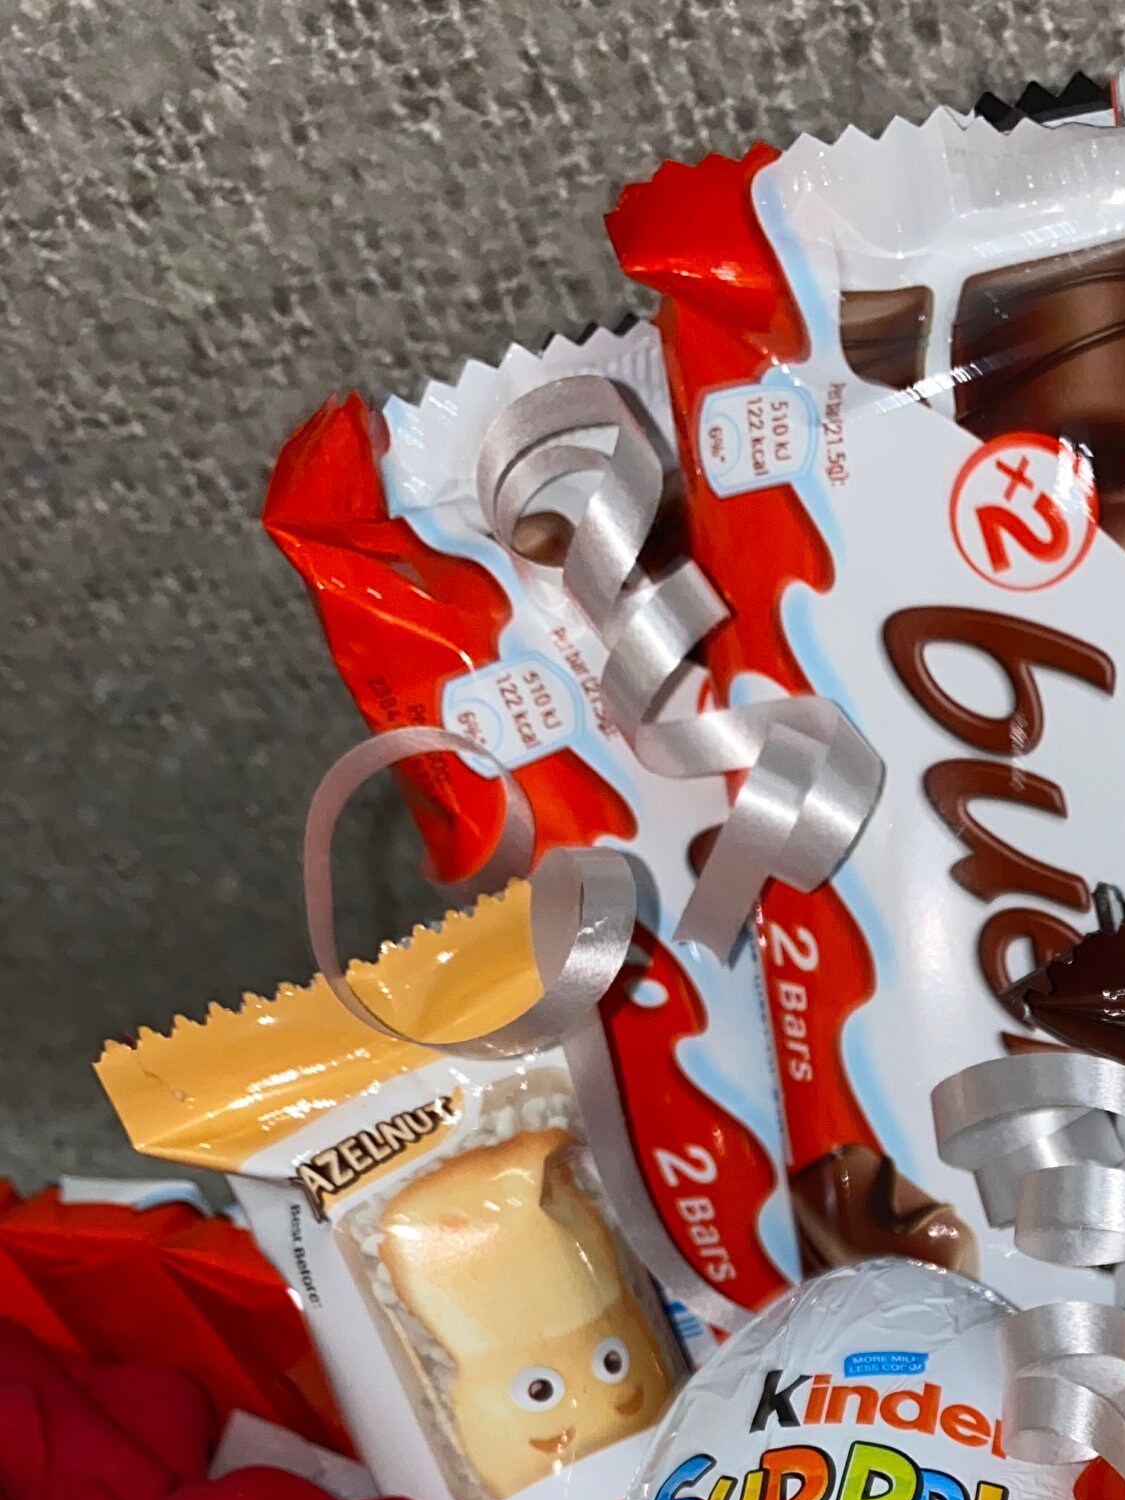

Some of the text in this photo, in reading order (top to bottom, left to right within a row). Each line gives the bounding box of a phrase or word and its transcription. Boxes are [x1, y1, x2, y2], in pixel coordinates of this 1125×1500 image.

[747, 396, 769, 477] 122 kcal
[770, 401, 792, 461] 510 kJ
[496, 673, 542, 749] 122 kcal
[523, 671, 562, 730] 510 kJ
[880, 604, 1118, 1055] bue
[768, 922, 820, 972] 2
[776, 982, 814, 1082] Bars
[288, 1095, 453, 1223] AZELNUT
[290, 1204, 303, 1244] Best
[653, 1141, 737, 1282] 2 Bars
[849, 1364, 879, 1373] LESS
